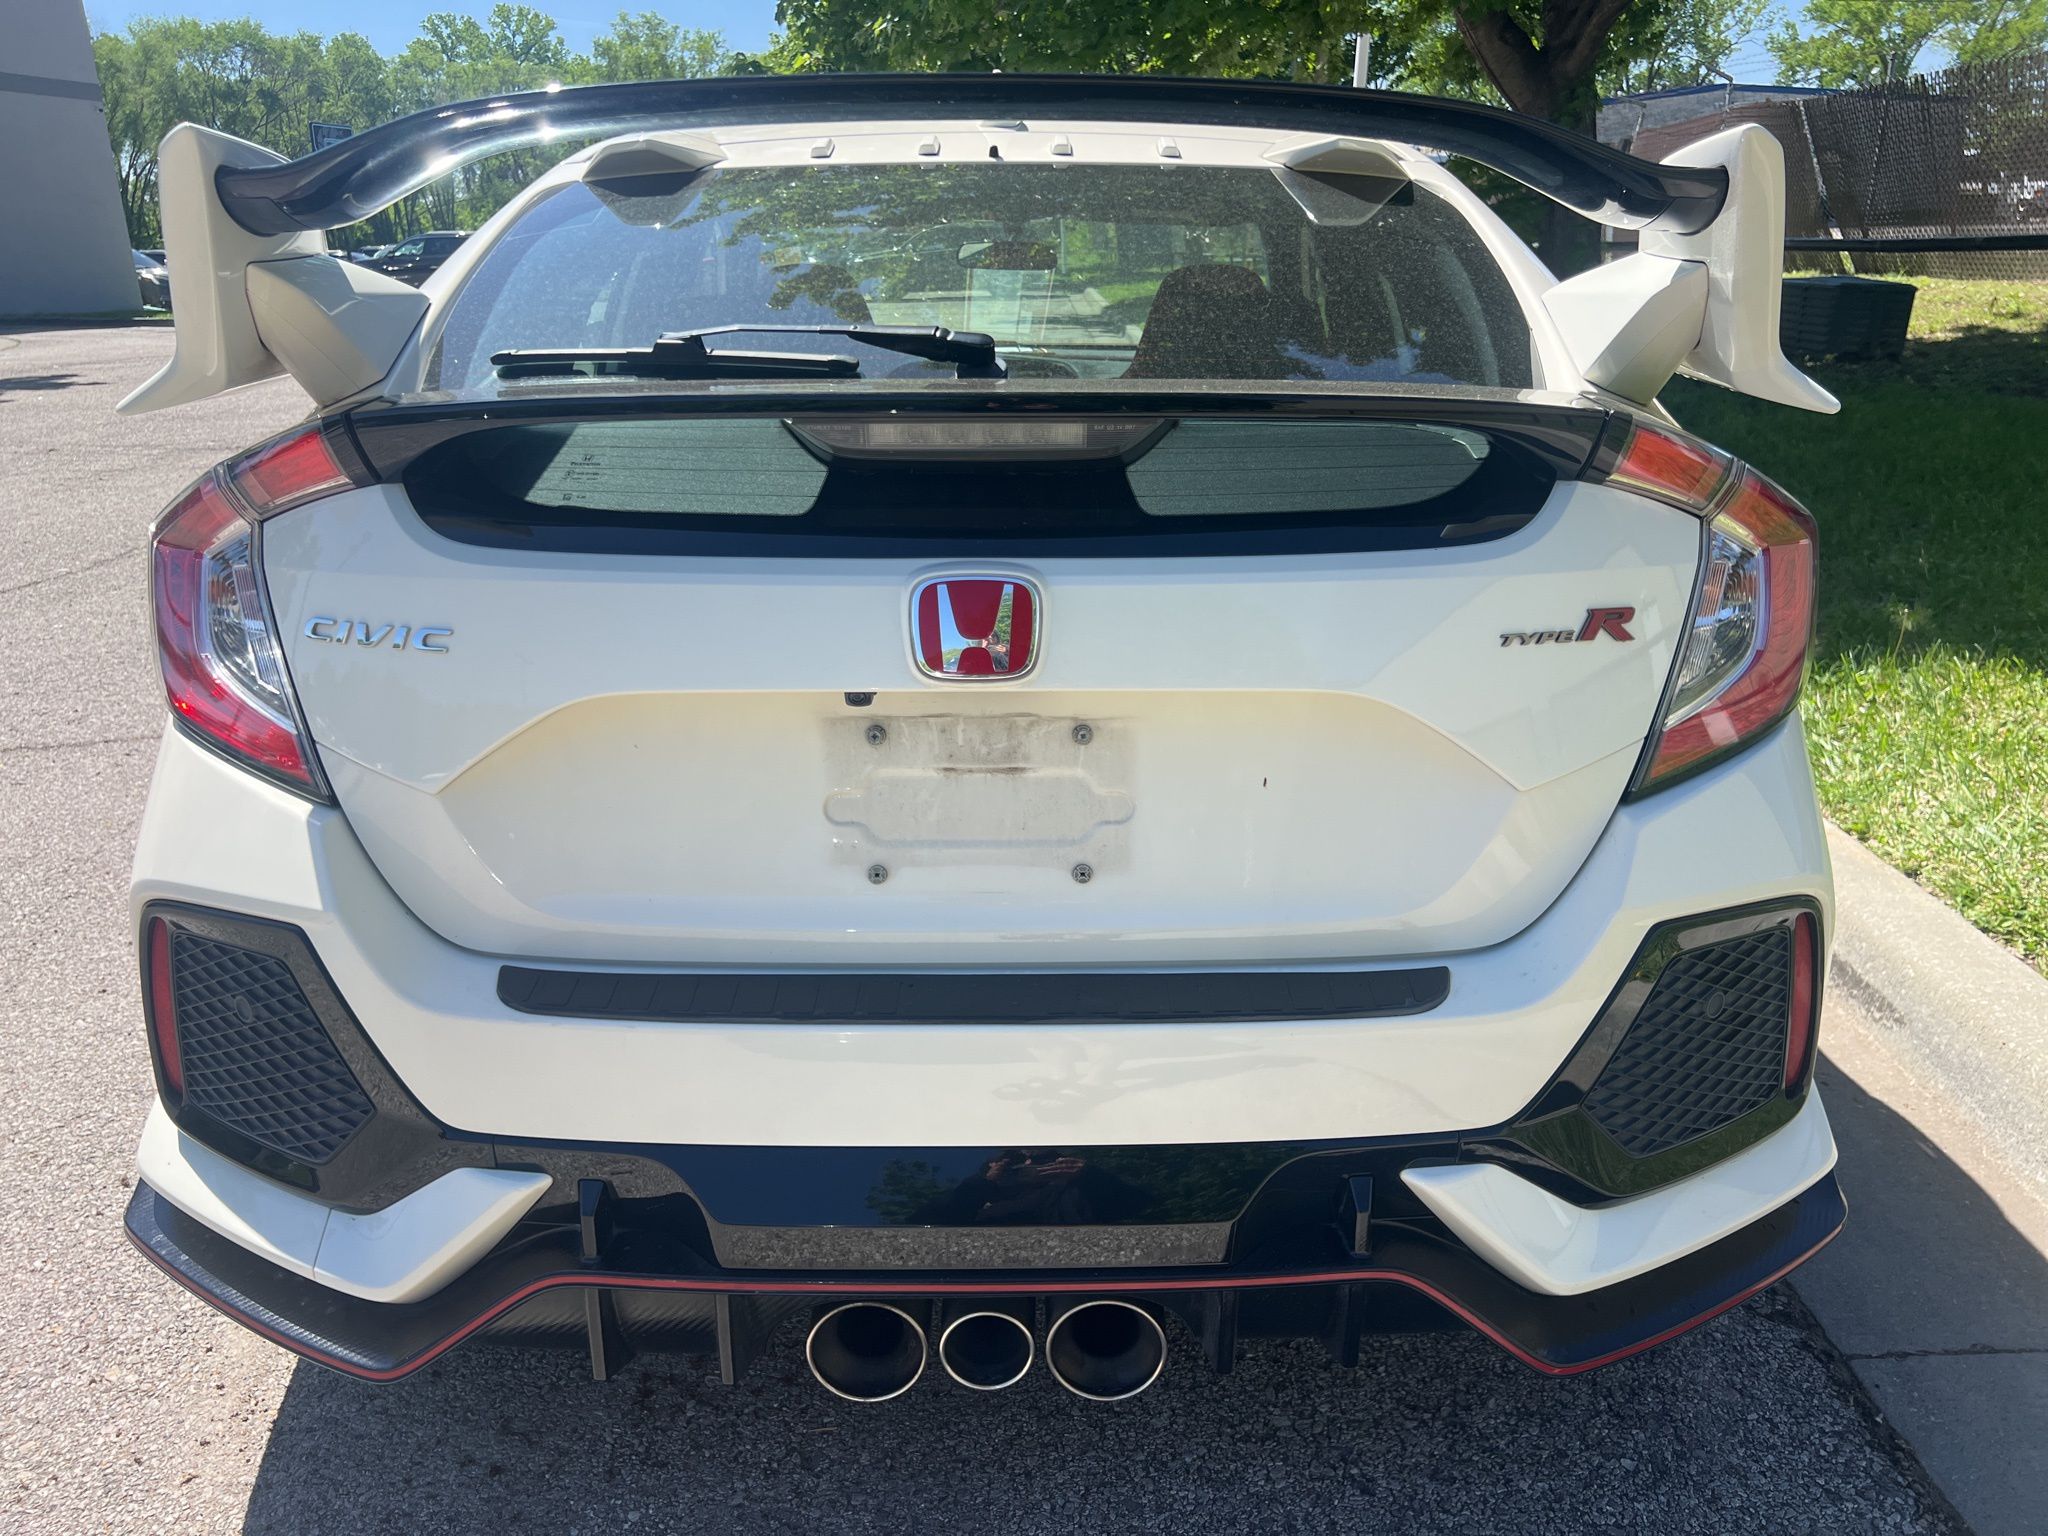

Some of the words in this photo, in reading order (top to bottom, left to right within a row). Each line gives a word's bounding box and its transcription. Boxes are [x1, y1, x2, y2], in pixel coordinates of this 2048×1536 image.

[304, 616, 453, 653] CIVIC
[1499, 630, 1575, 647] TYPE
[1575, 607, 1635, 642] R
